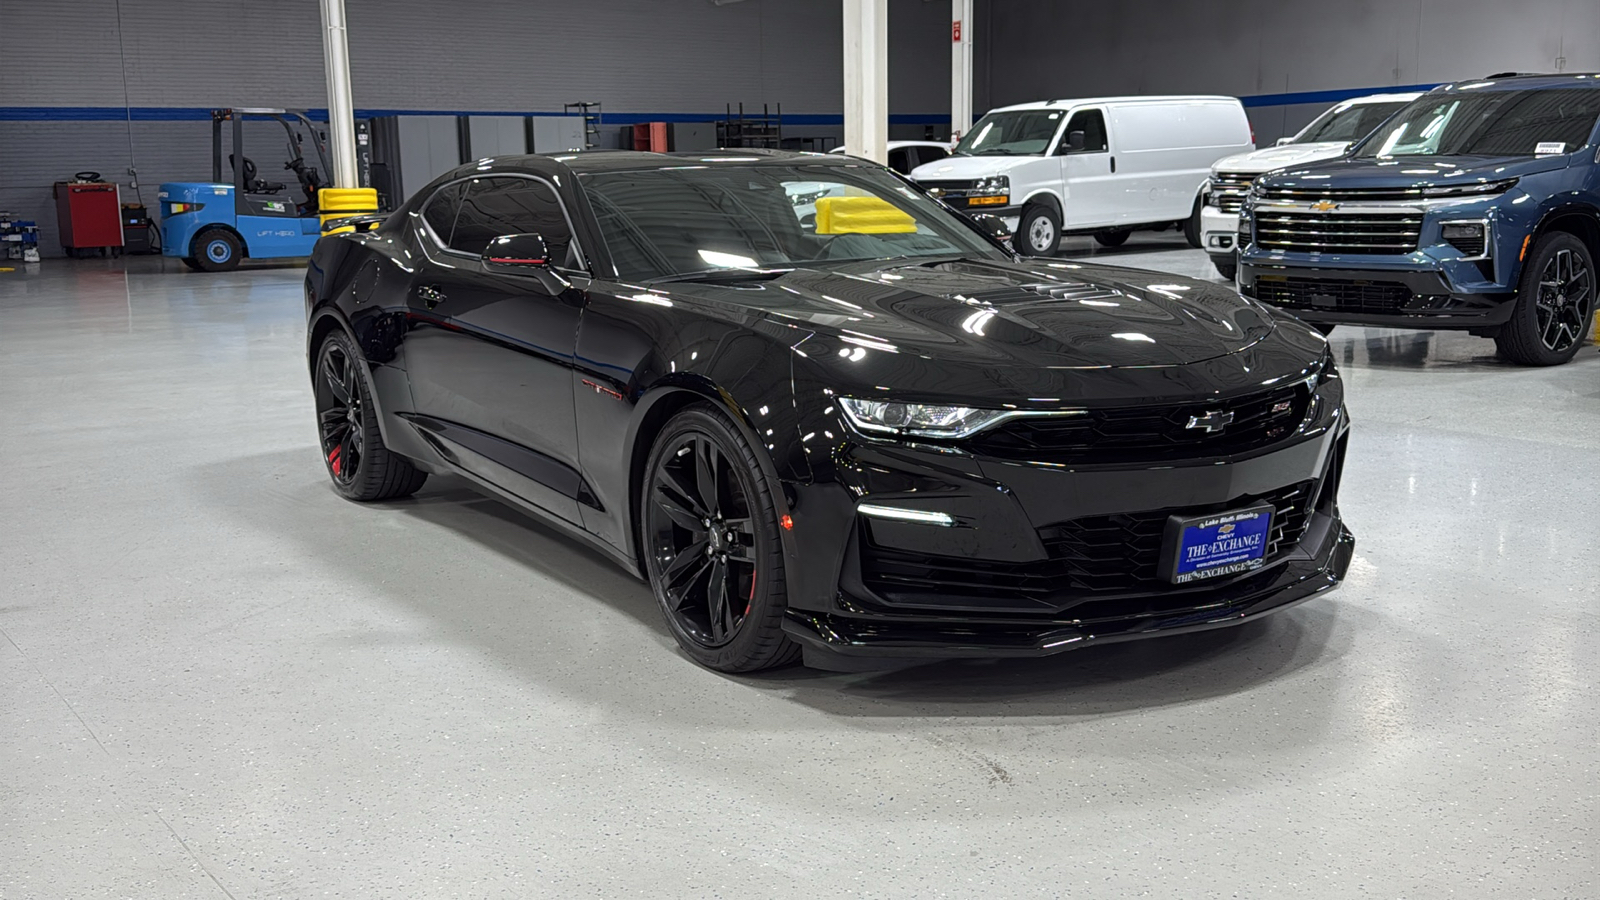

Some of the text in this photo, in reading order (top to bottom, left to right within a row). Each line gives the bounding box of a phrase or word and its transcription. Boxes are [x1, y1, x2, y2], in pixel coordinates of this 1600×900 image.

[1205, 519, 1219, 527] Lake
[1216, 532, 1235, 540] CHEVY
[1187, 533, 1261, 558] THE EXCHANGE
[1176, 563, 1247, 584] THE EXCHANGE
